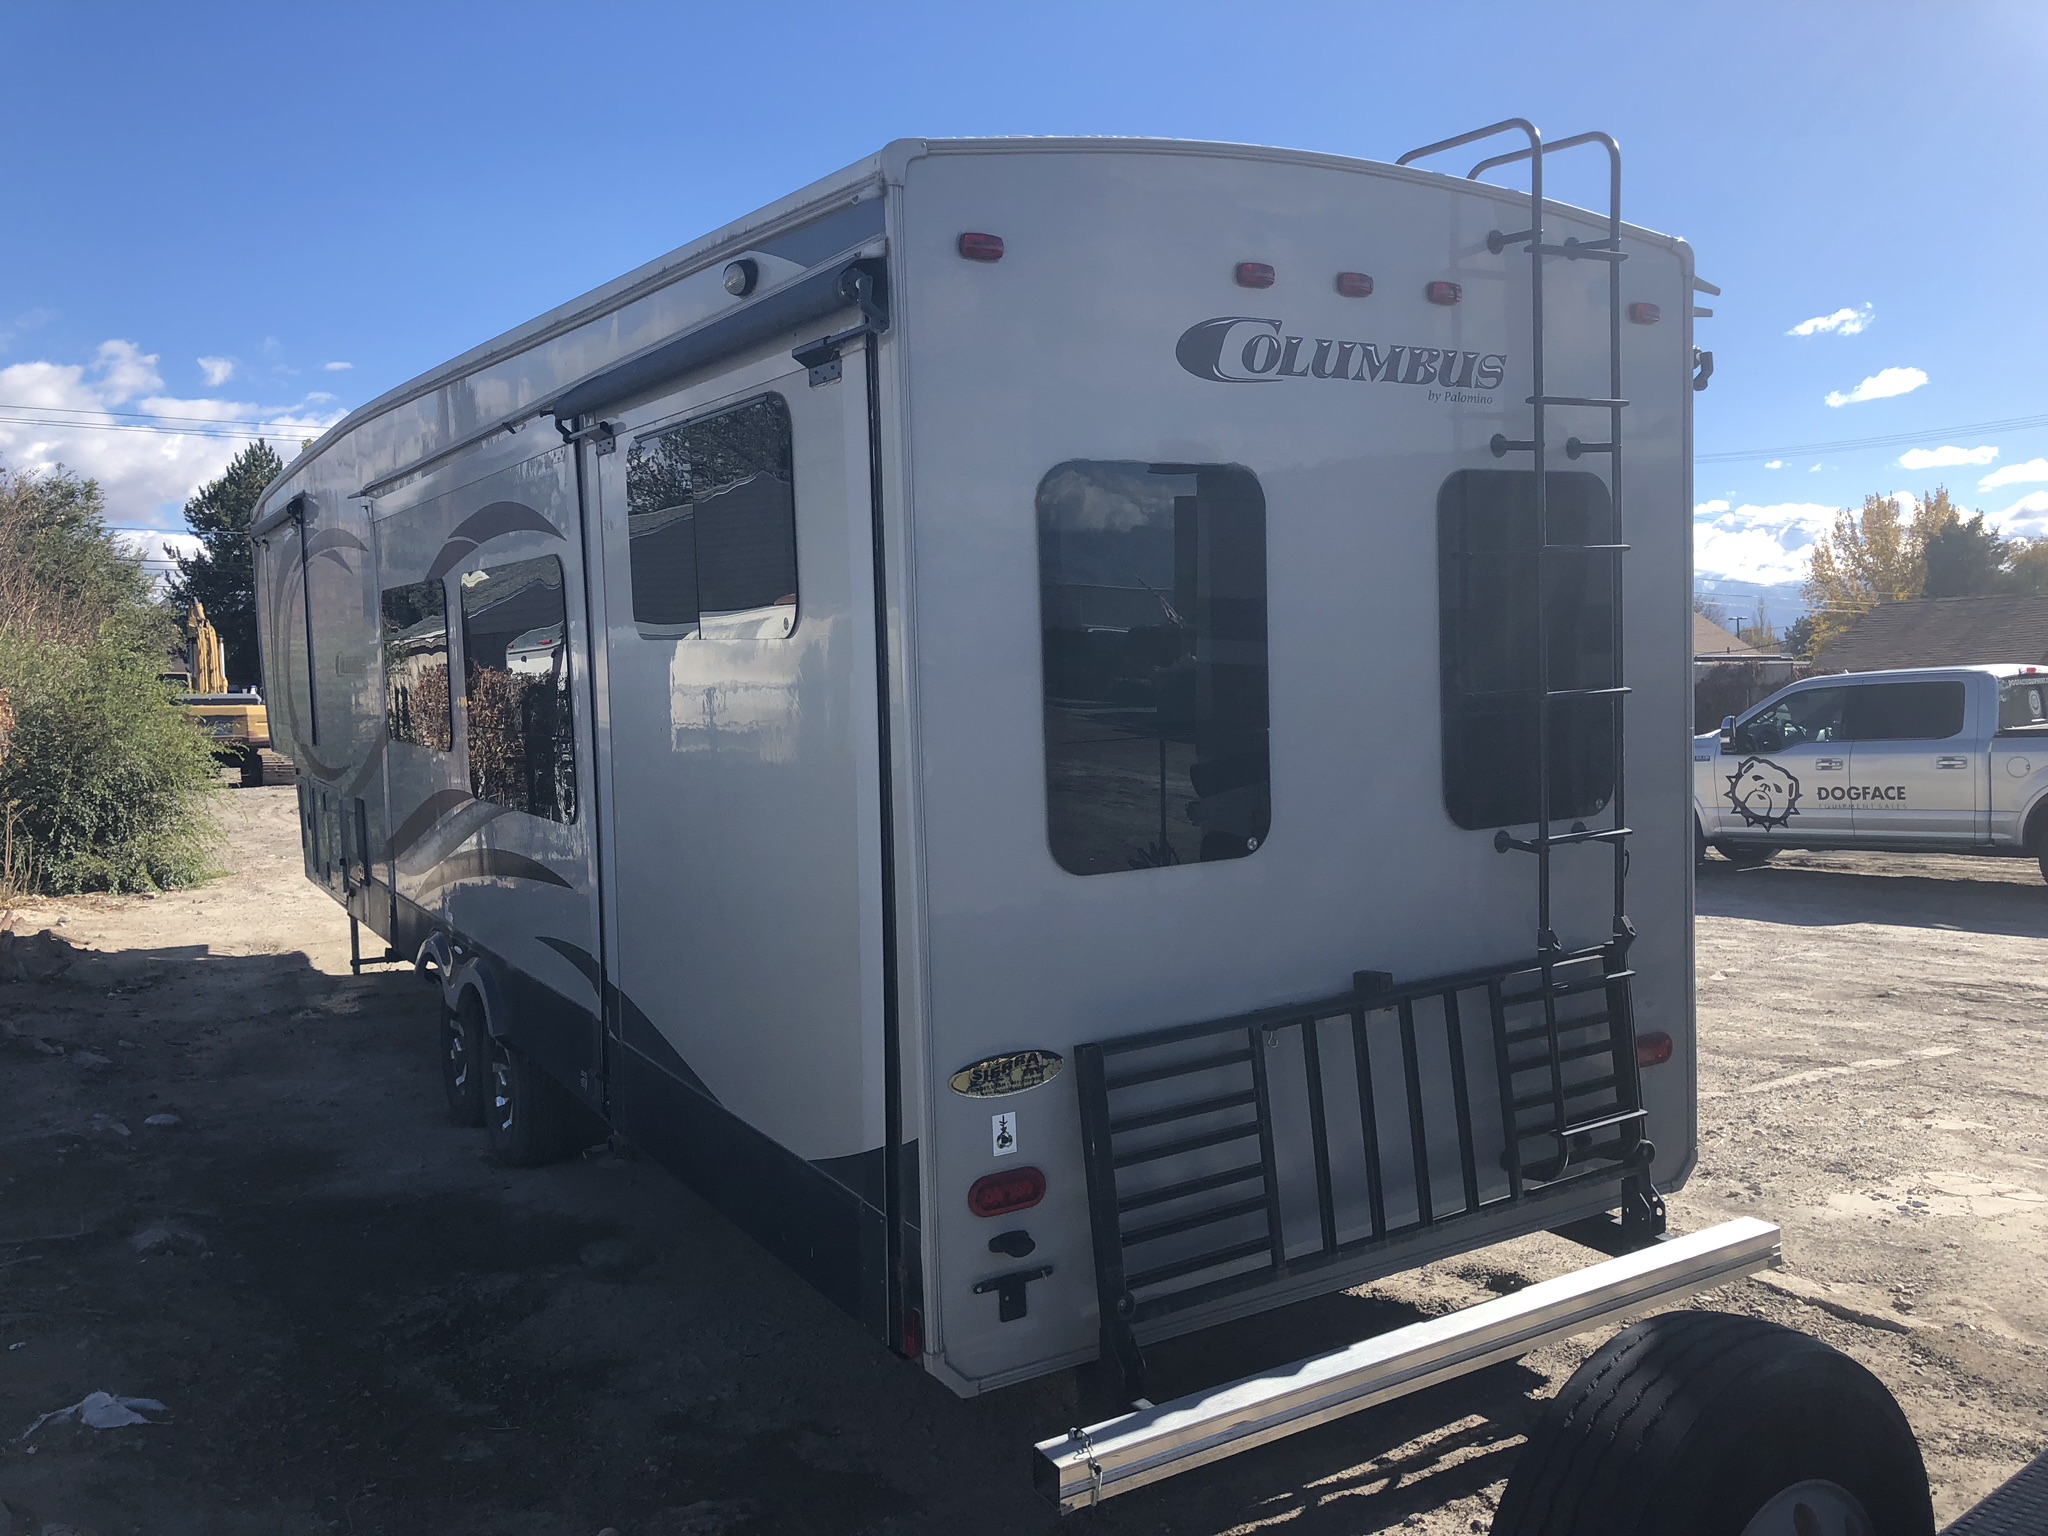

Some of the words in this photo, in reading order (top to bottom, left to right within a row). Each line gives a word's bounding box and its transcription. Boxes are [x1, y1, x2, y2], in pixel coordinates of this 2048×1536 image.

[1175, 316, 1508, 390] COLUMBUS
[1428, 390, 1441, 403] by
[1444, 391, 1493, 404] Palomino
[1817, 786, 1906, 800] DOGFACE
[972, 1052, 1040, 1083] SIERRA
